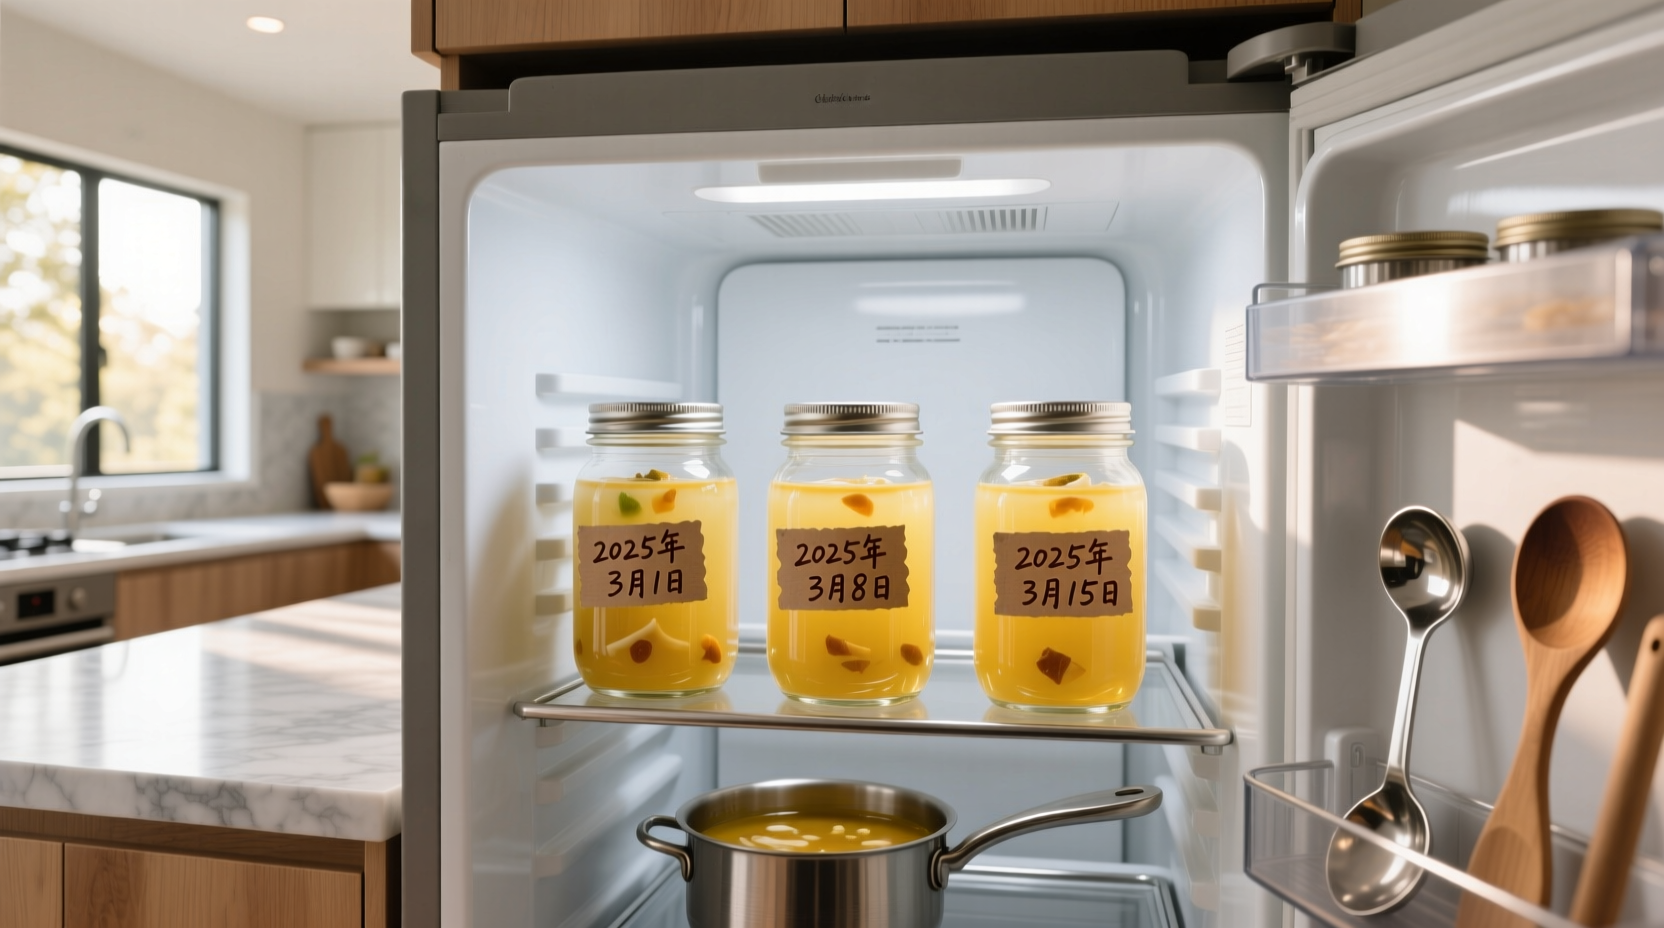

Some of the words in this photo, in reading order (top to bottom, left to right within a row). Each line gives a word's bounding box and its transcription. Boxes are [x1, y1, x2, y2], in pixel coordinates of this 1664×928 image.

[593, 529, 685, 564] 2025年
[794, 534, 887, 570] 2025年
[1014, 538, 1113, 575] 2025年
[608, 569, 684, 599] 3月1日
[808, 573, 890, 604] 3月8日
[1021, 578, 1117, 609] 3月15日
